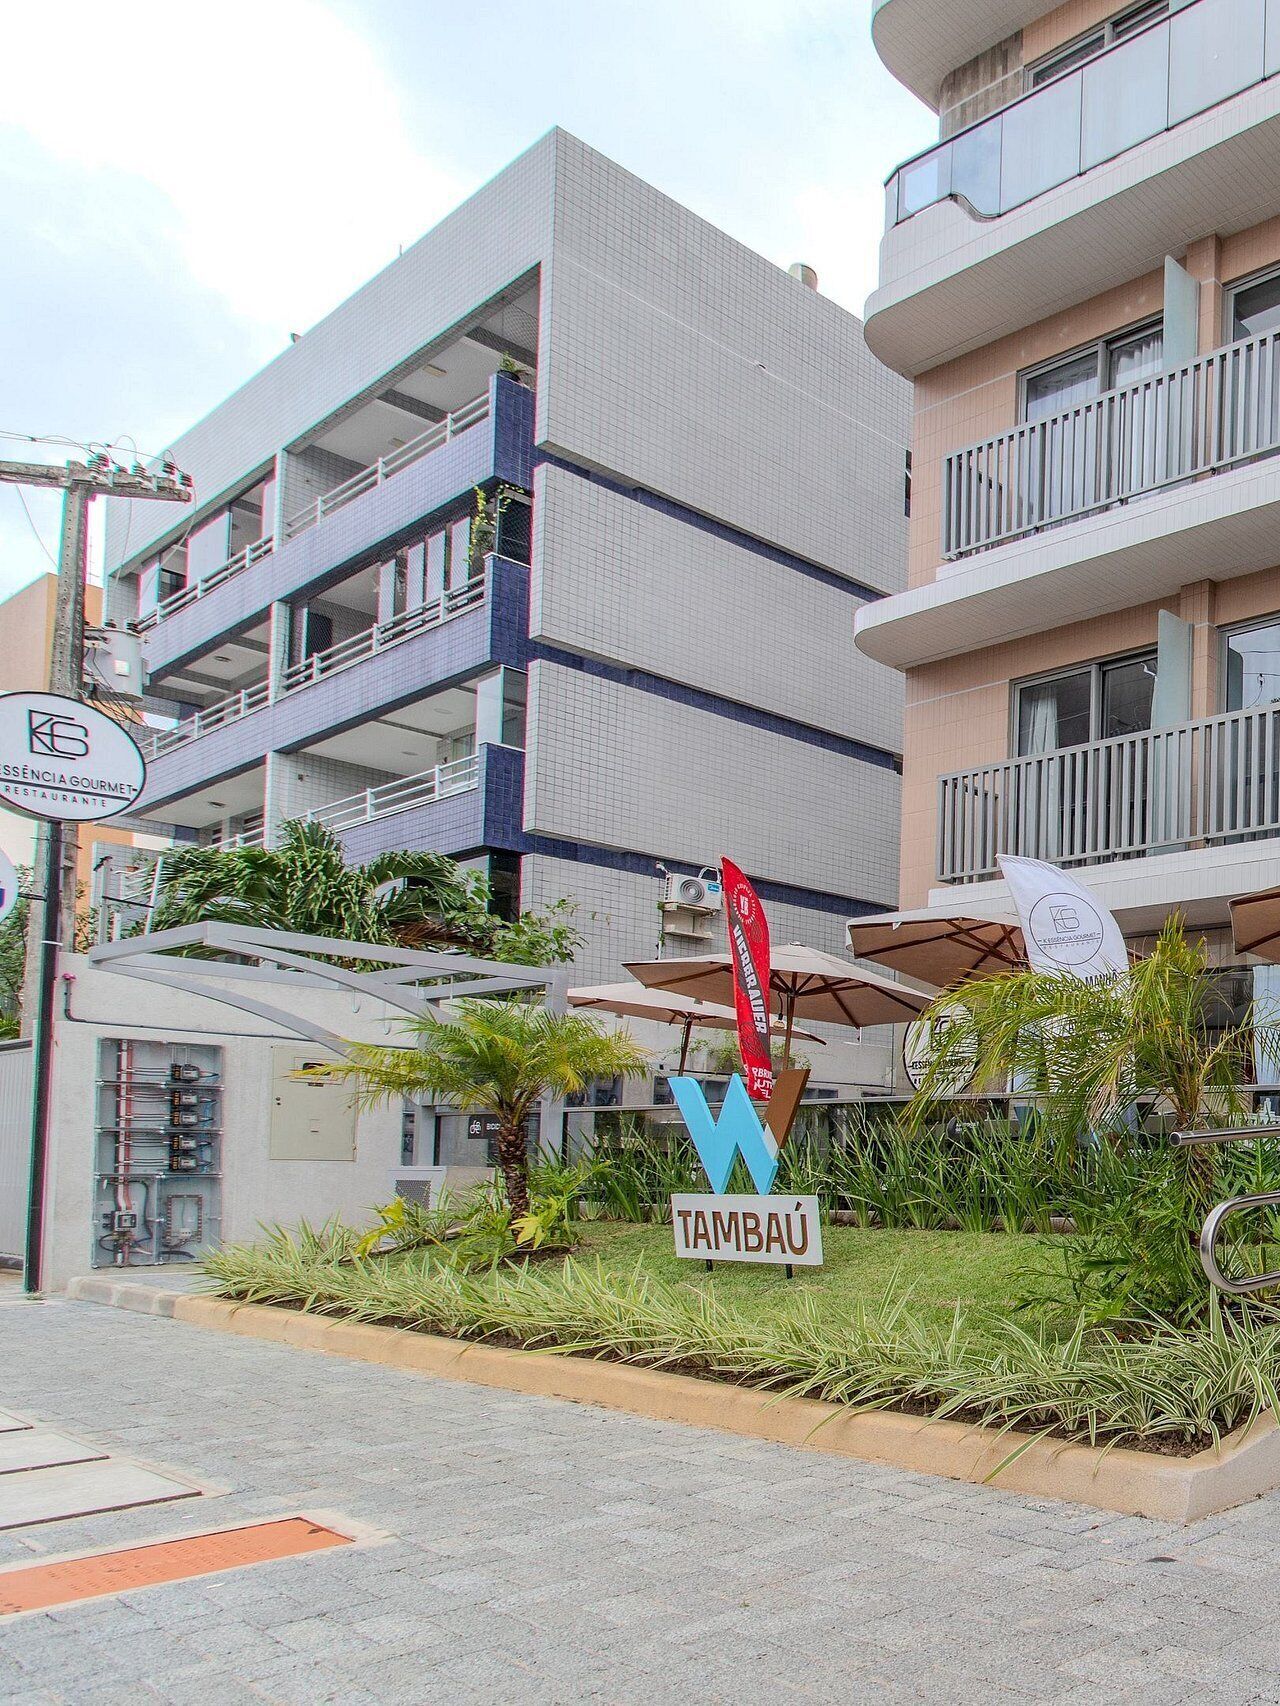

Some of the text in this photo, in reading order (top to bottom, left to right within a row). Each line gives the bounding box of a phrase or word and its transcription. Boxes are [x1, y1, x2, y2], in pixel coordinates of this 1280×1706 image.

[5, 785, 106, 807] RESTAURANTE
[70, 775, 133, 795] GOURMET
[677, 1201, 809, 1256] TAMBAÚ
